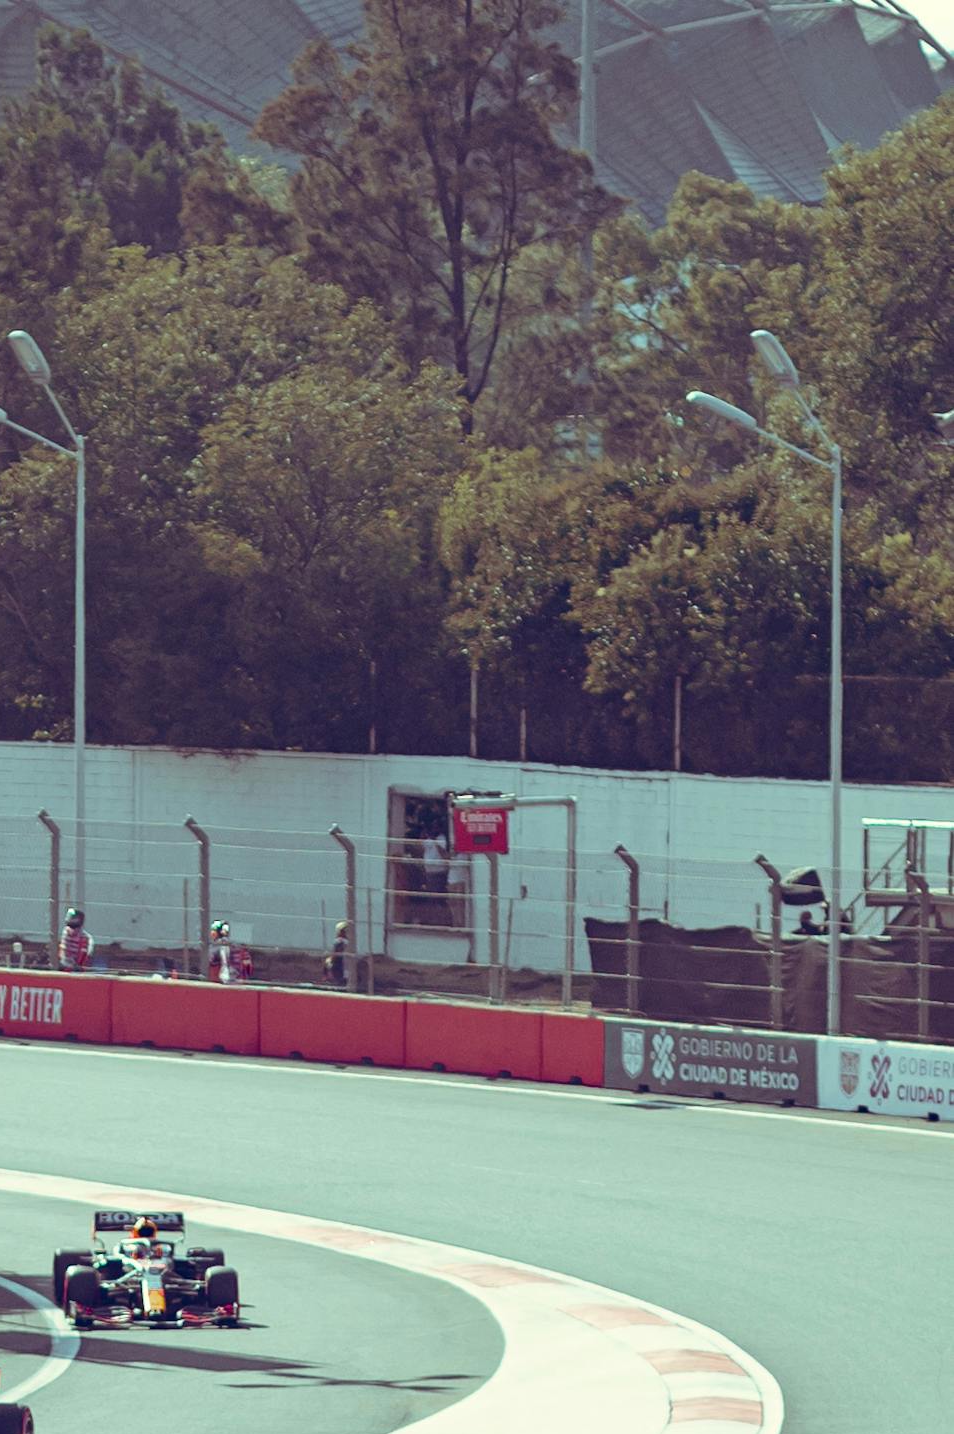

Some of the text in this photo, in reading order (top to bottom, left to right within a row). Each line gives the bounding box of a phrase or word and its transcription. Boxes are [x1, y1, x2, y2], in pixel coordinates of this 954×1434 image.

[9, 985, 64, 1024] BETTER
[679, 1037, 799, 1064] GOBIERNO DE LA
[679, 1063, 800, 1091] CIUDAD DE MÉXICO
[898, 1056, 954, 1079] GOBIER
[897, 1084, 945, 1104] CIUDAD
